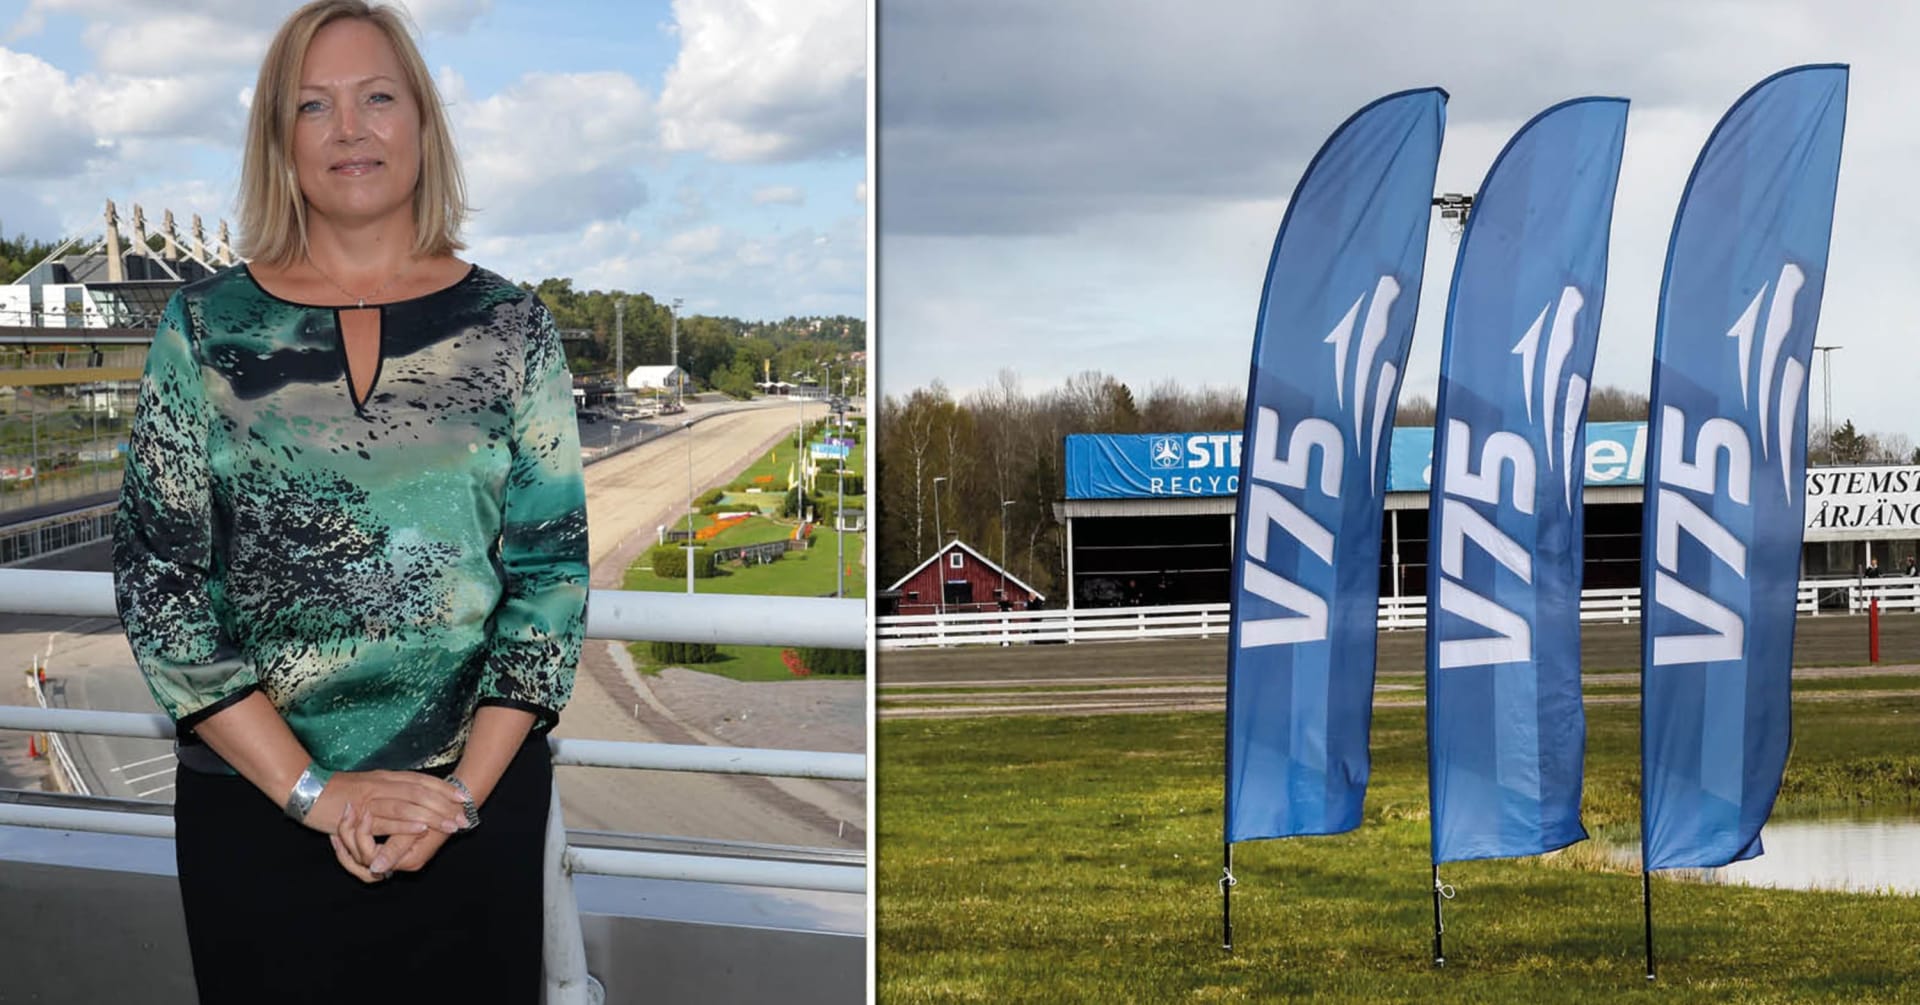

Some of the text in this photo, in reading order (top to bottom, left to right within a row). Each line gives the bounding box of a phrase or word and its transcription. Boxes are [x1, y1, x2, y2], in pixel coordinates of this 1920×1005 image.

[1151, 475, 1240, 494] RECYC
[1240, 405, 1345, 648] V75
[1439, 417, 1537, 669] V75
[1652, 404, 1751, 666] V75
[1806, 470, 1920, 496] STEMS
